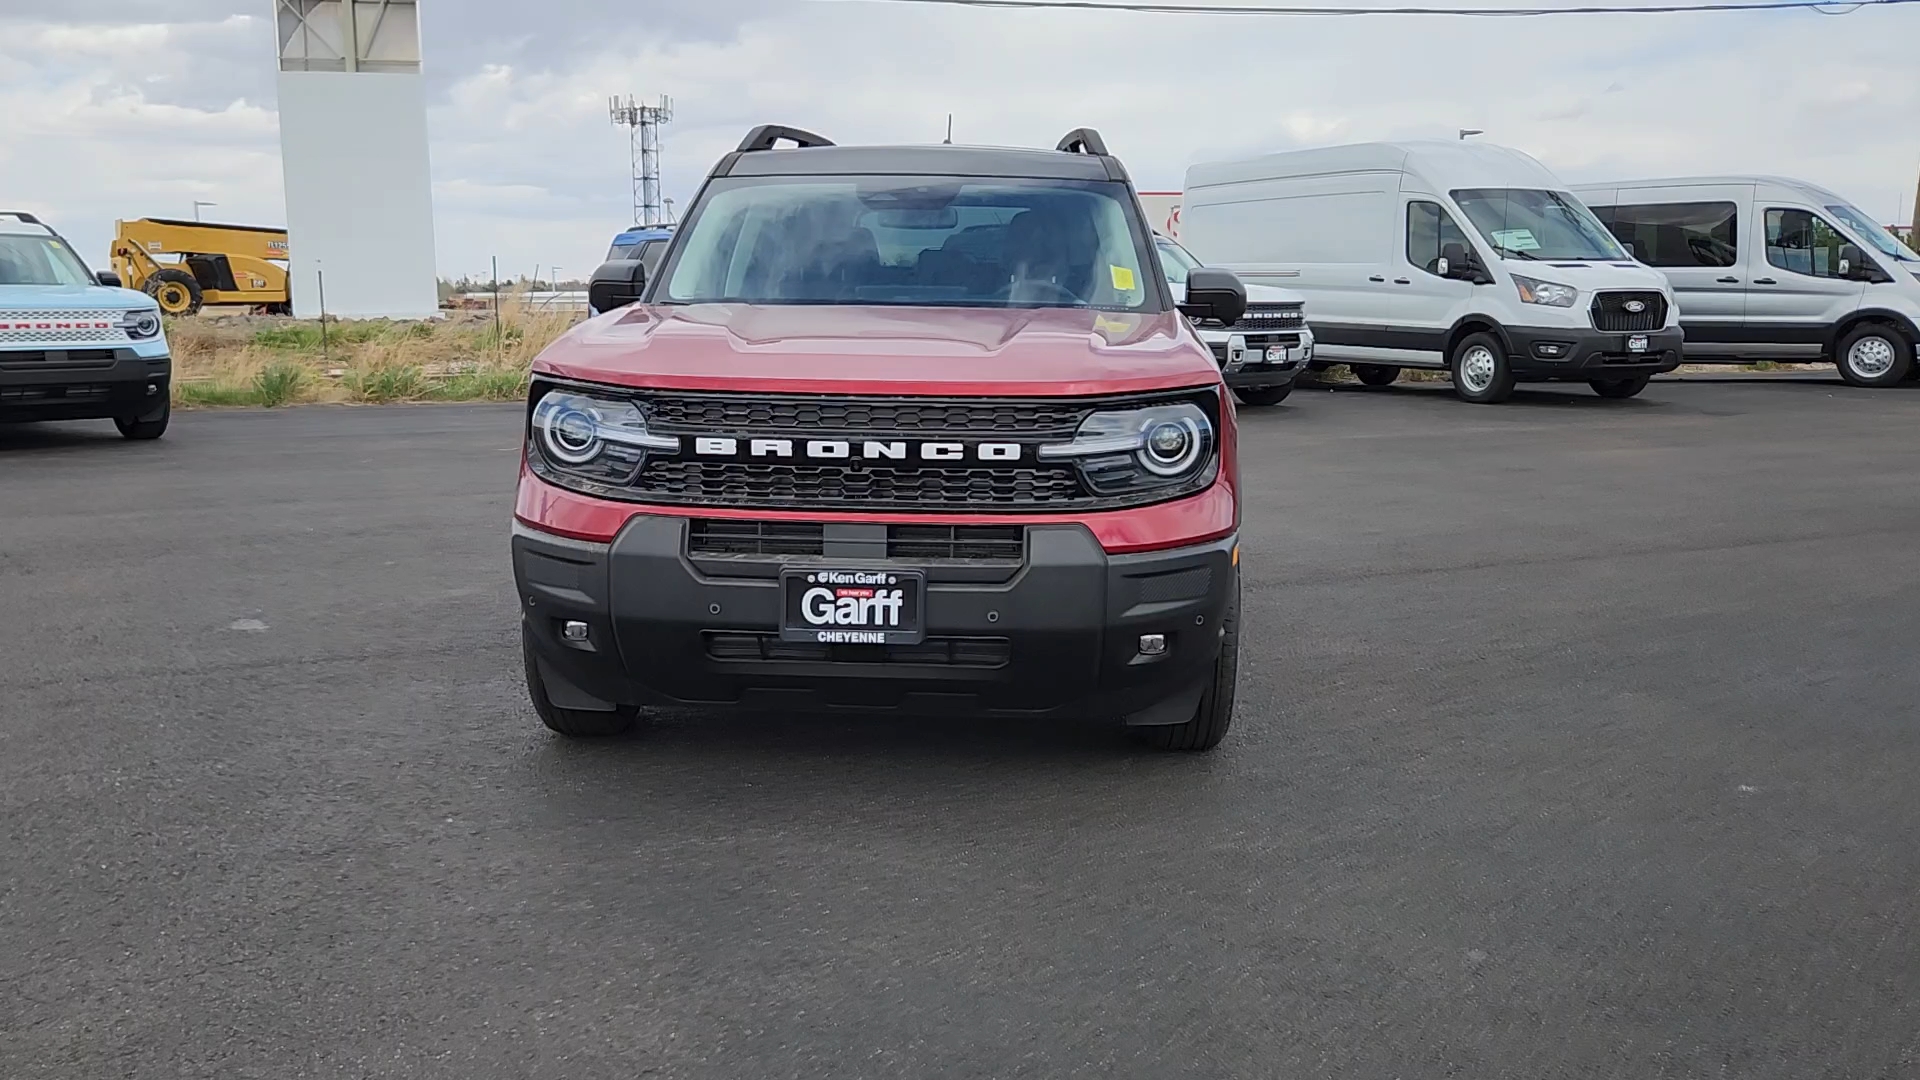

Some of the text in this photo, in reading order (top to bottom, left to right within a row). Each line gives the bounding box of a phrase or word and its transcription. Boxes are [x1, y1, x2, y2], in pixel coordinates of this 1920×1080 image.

[695, 437, 1021, 460] BRONCO
[828, 572, 887, 585] Ken Garff
[801, 587, 903, 626] Garff
[817, 631, 885, 644] CHEYENNE
